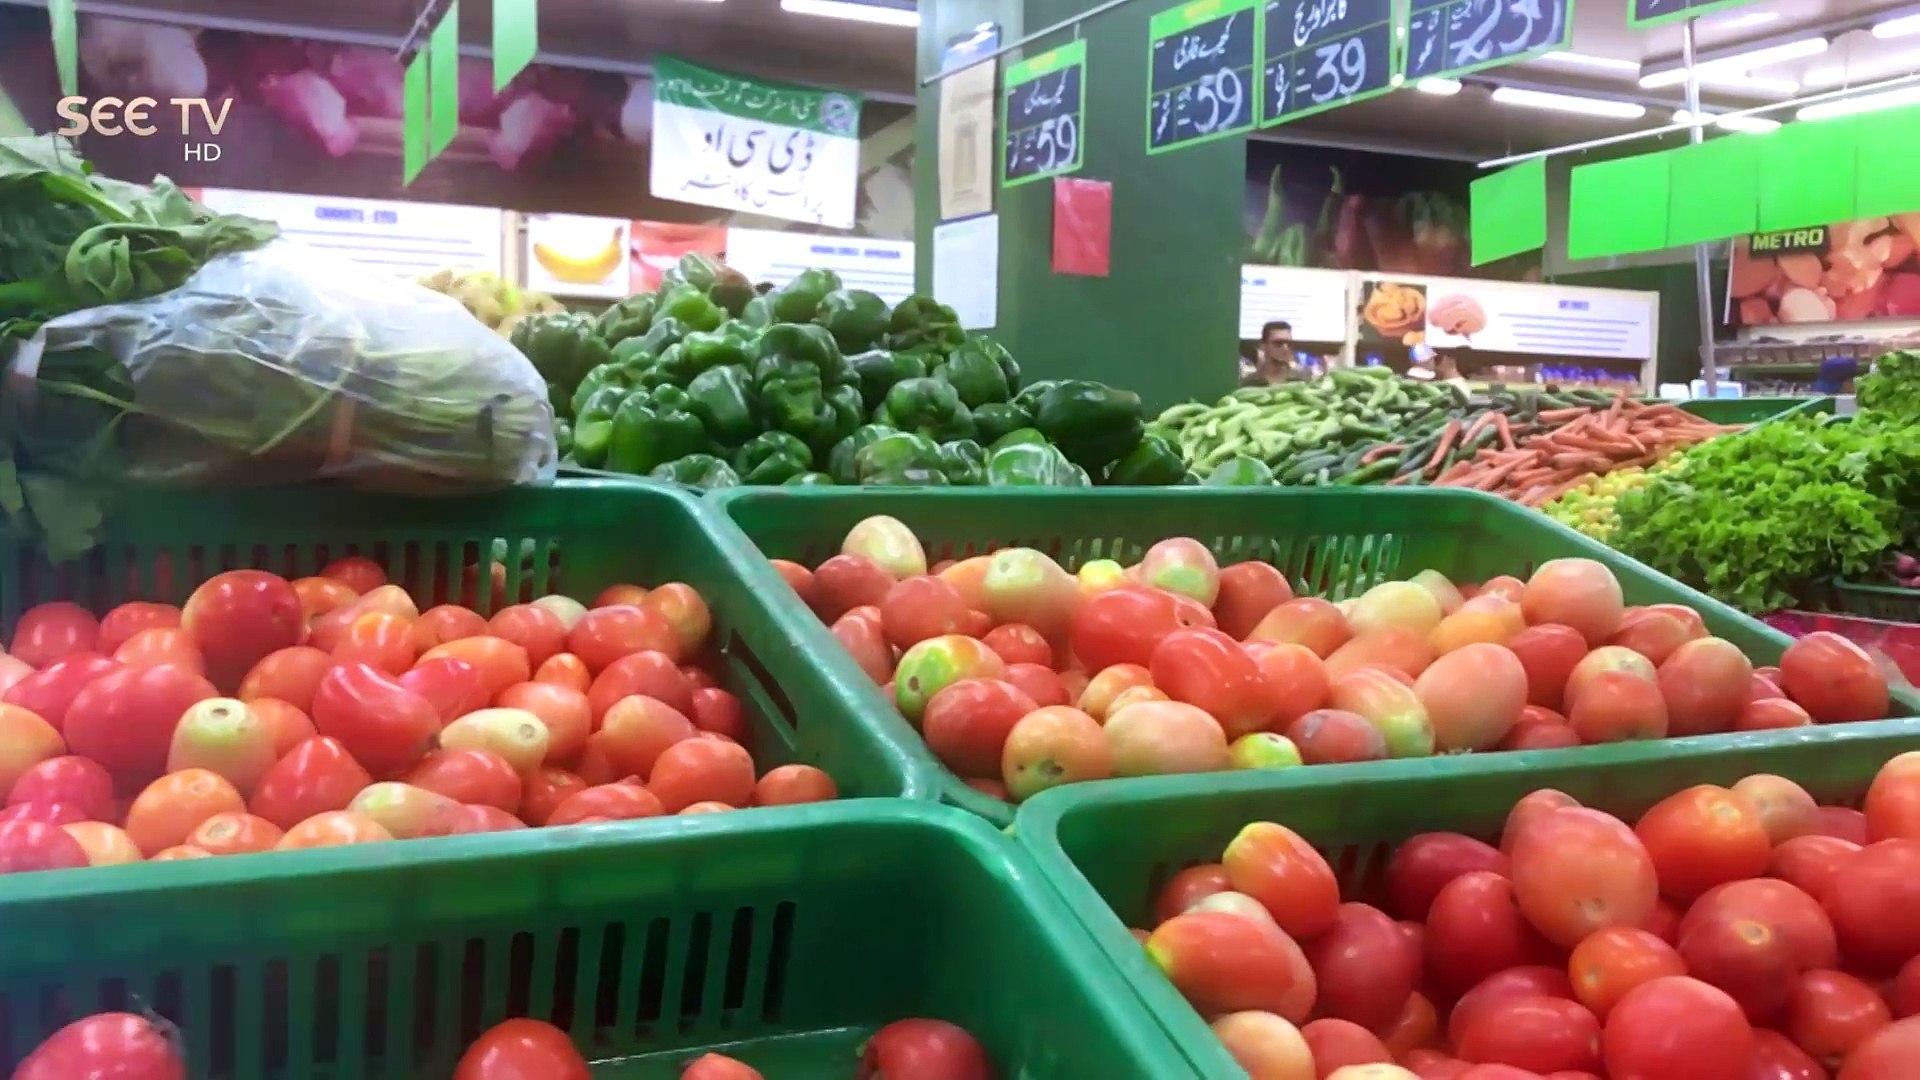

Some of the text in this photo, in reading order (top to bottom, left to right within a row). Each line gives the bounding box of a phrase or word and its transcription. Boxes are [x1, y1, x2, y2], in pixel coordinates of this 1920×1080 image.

[1194, 67, 1243, 133] 59
[1312, 37, 1367, 103] 39
[1037, 114, 1077, 173] 59
[1752, 228, 1825, 251] METRO
